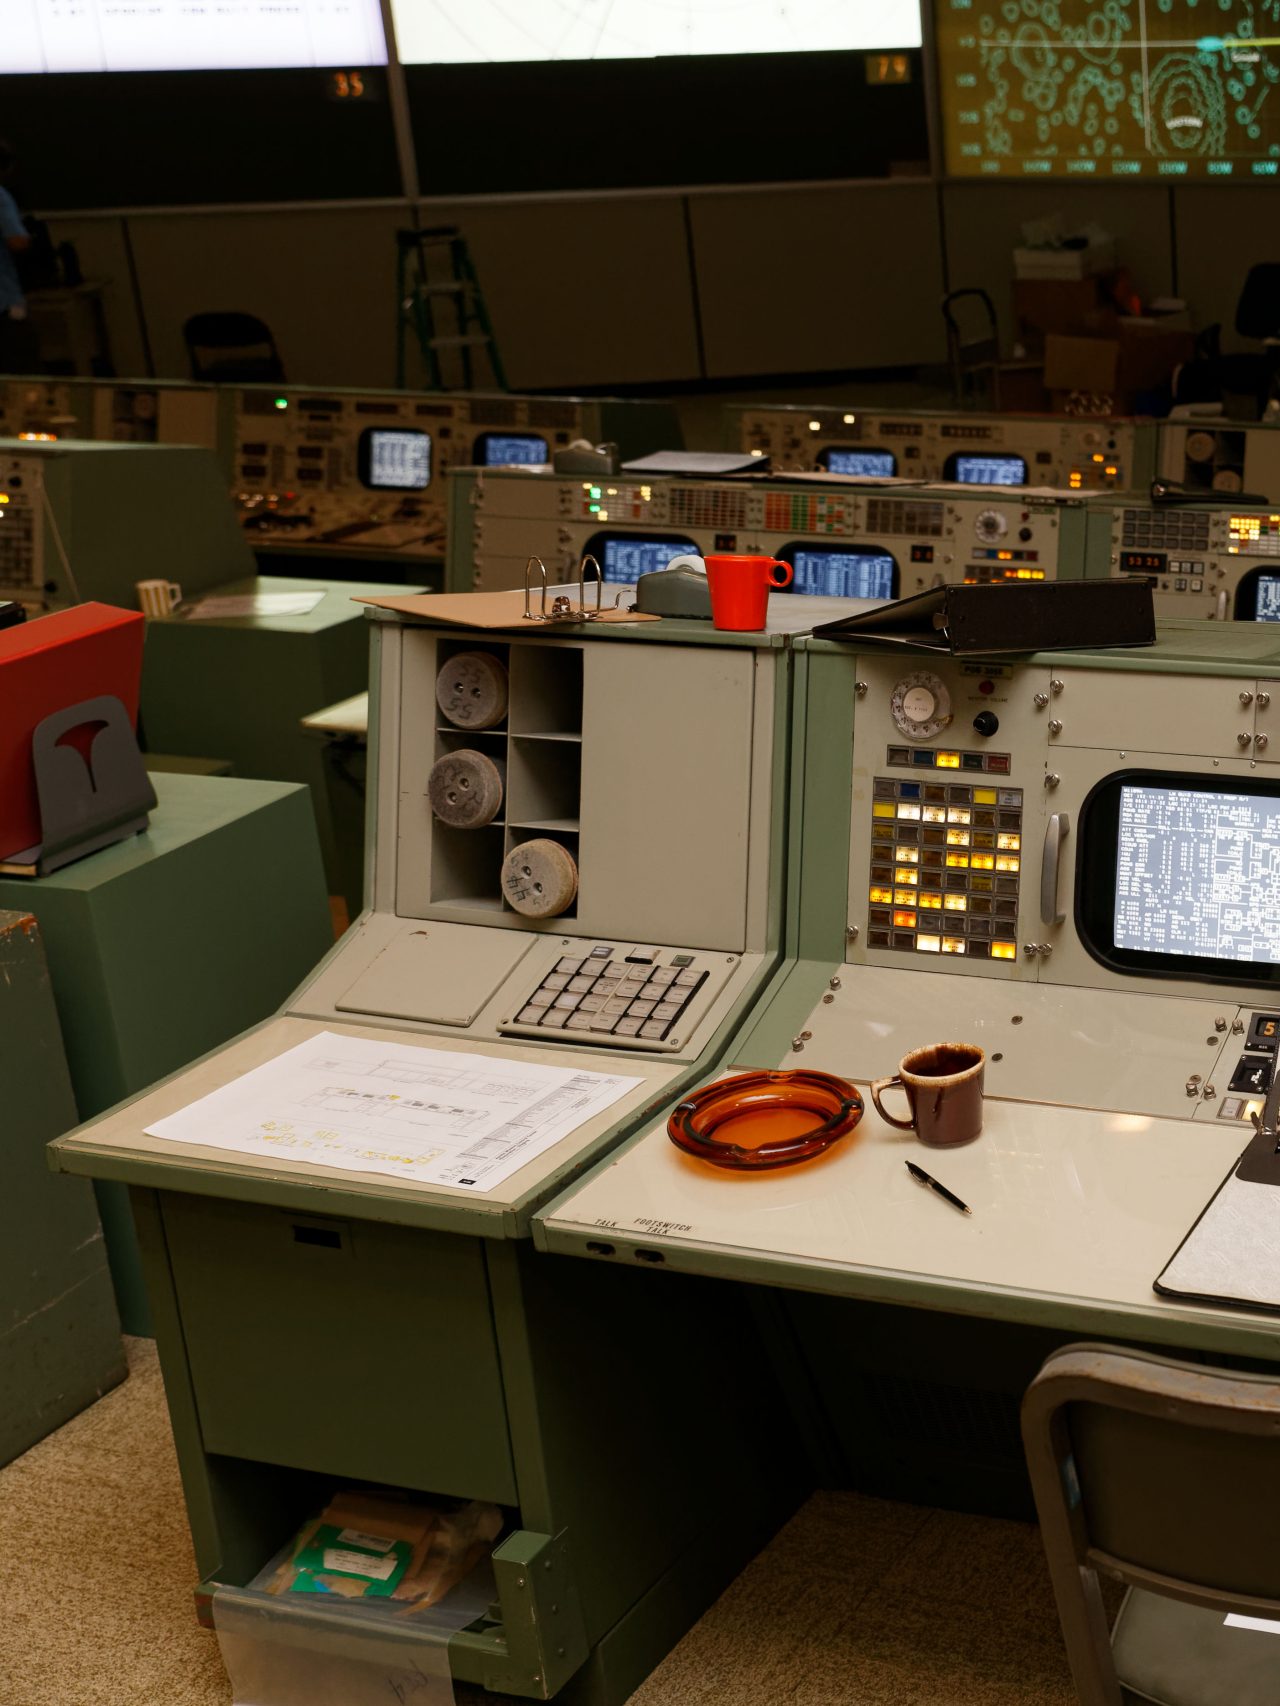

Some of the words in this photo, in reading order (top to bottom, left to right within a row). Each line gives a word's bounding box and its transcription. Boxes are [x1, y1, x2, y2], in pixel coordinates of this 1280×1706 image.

[1263, 1021, 1275, 1037] 5
[594, 1218, 618, 1228] TALK
[633, 1217, 693, 1232] FOOTSWITCH
[646, 1226, 670, 1235] TALK
